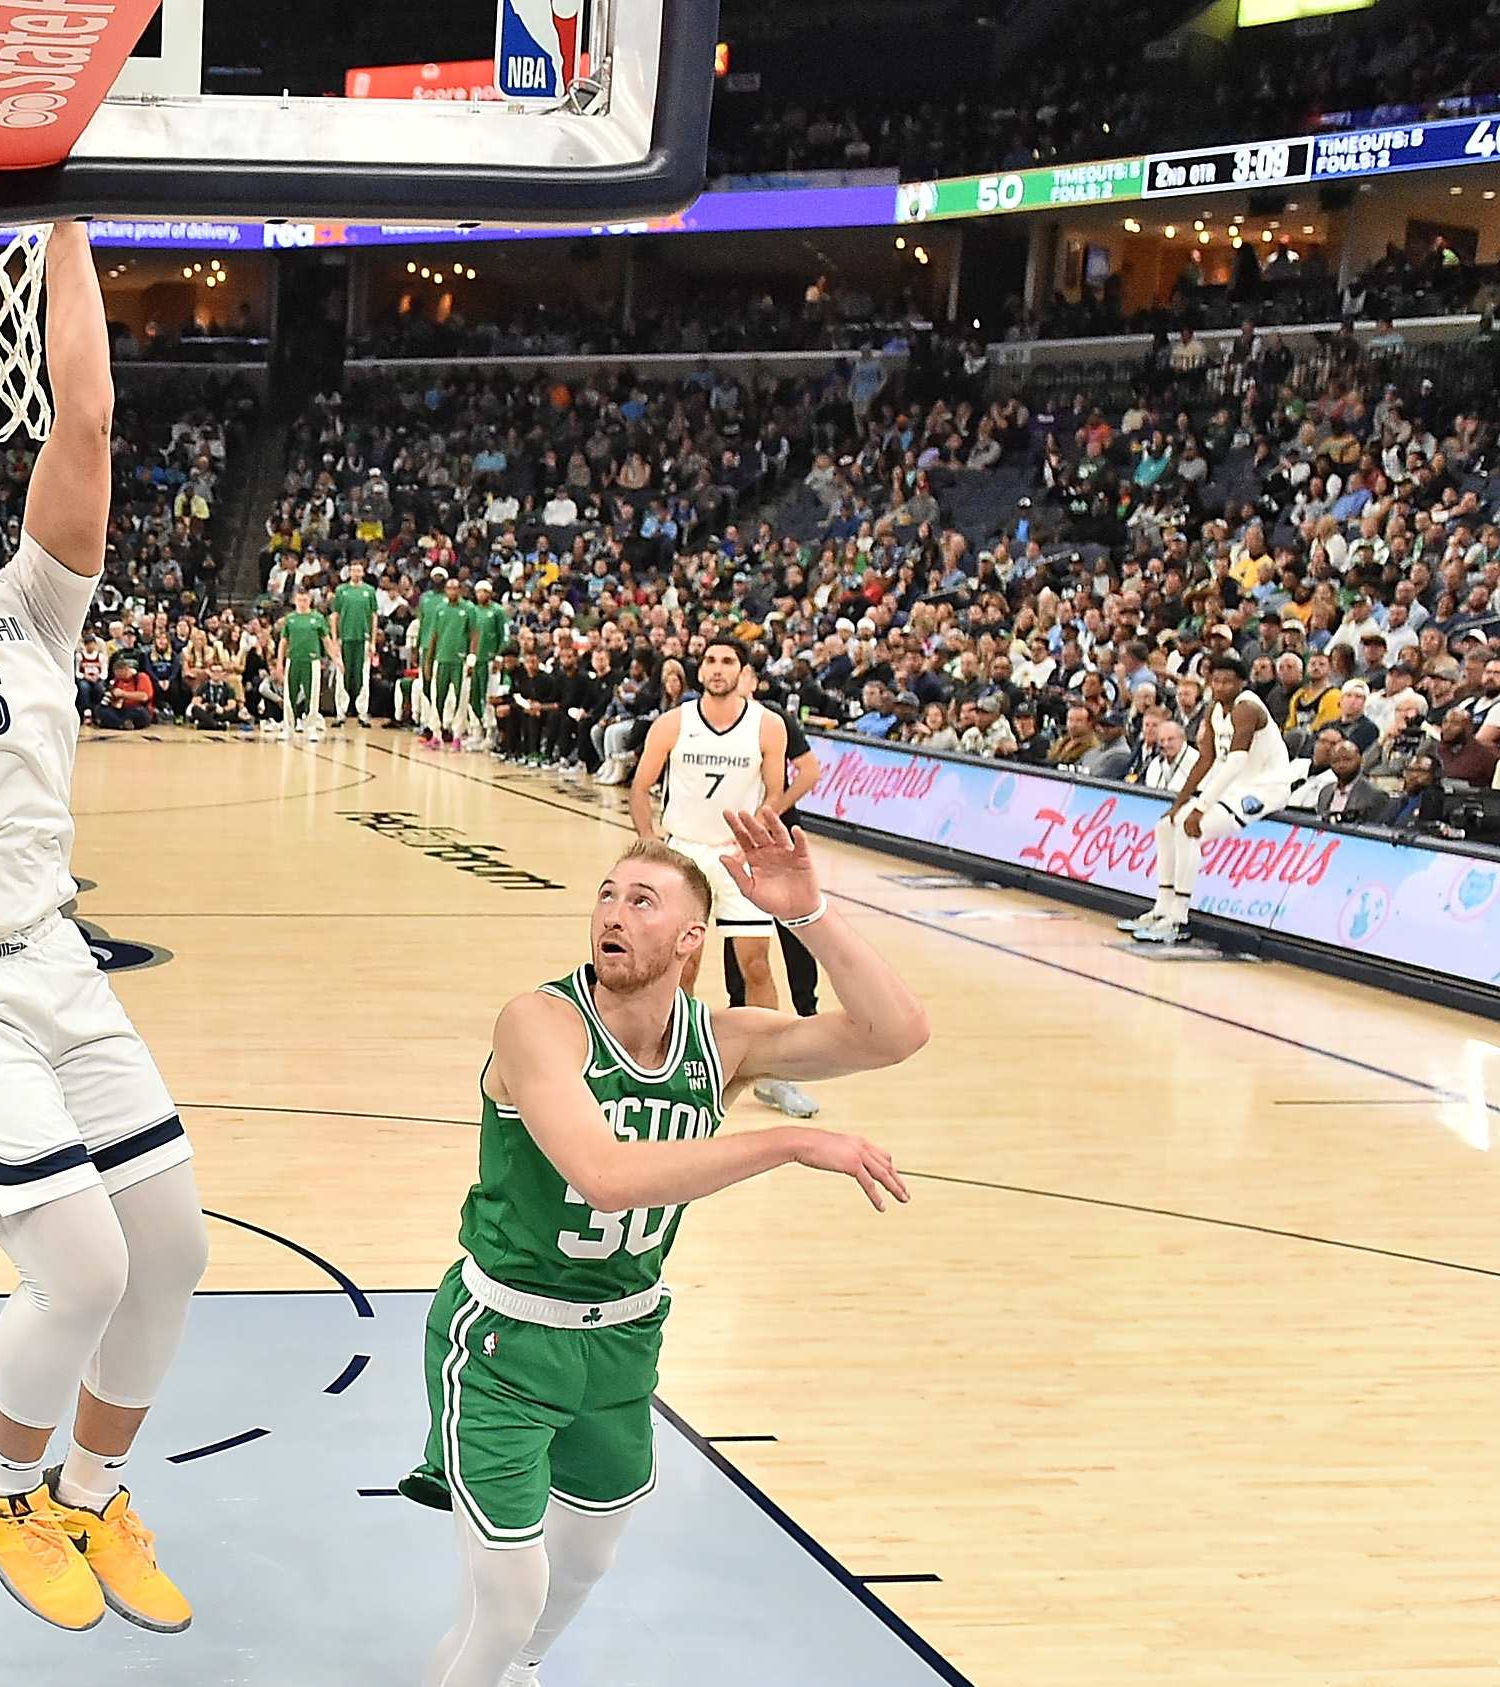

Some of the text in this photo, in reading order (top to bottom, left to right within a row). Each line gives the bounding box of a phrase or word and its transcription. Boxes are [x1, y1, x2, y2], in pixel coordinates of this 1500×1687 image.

[507, 56, 547, 89] NBA
[1465, 120, 1500, 157] 4
[1155, 161, 1187, 189] 2ND
[1232, 145, 1291, 182] 3:09
[976, 174, 1025, 212] 50
[682, 752, 750, 768] MEMPHIS
[704, 772, 725, 799] 7
[821, 750, 941, 817] Memphis
[1020, 797, 1342, 889] I Love emphis
[557, 1184, 678, 1260] 30
